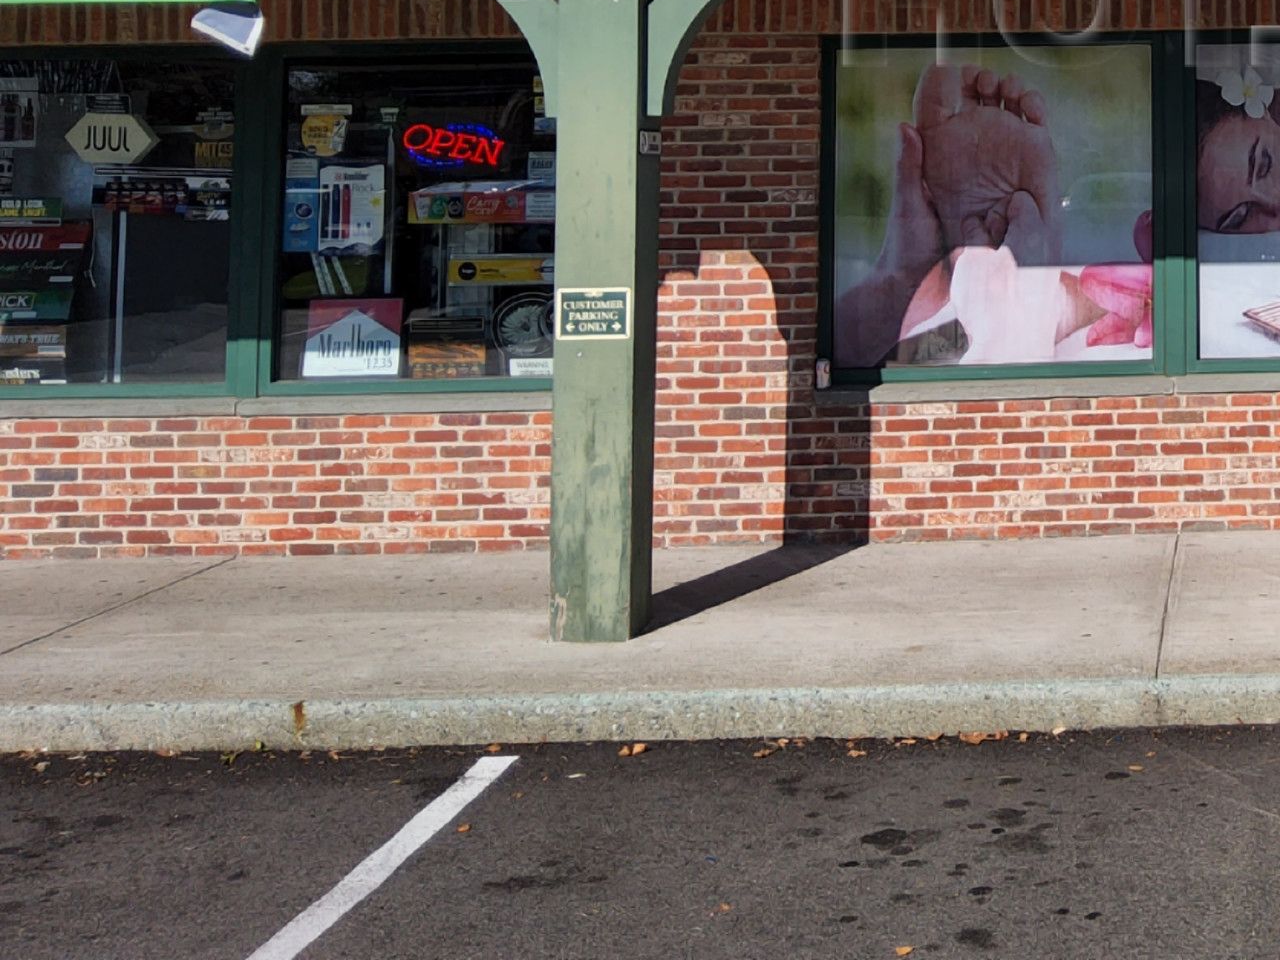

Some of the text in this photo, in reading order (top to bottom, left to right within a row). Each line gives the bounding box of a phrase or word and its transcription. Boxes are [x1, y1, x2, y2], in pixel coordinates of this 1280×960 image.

[84, 126, 131, 152] JUUL
[404, 124, 504, 165] OPEN
[563, 300, 624, 310] CUSTOMER
[568, 311, 619, 321] PARKING
[578, 322, 608, 332] ONLY
[318, 323, 391, 358] Marlboro
